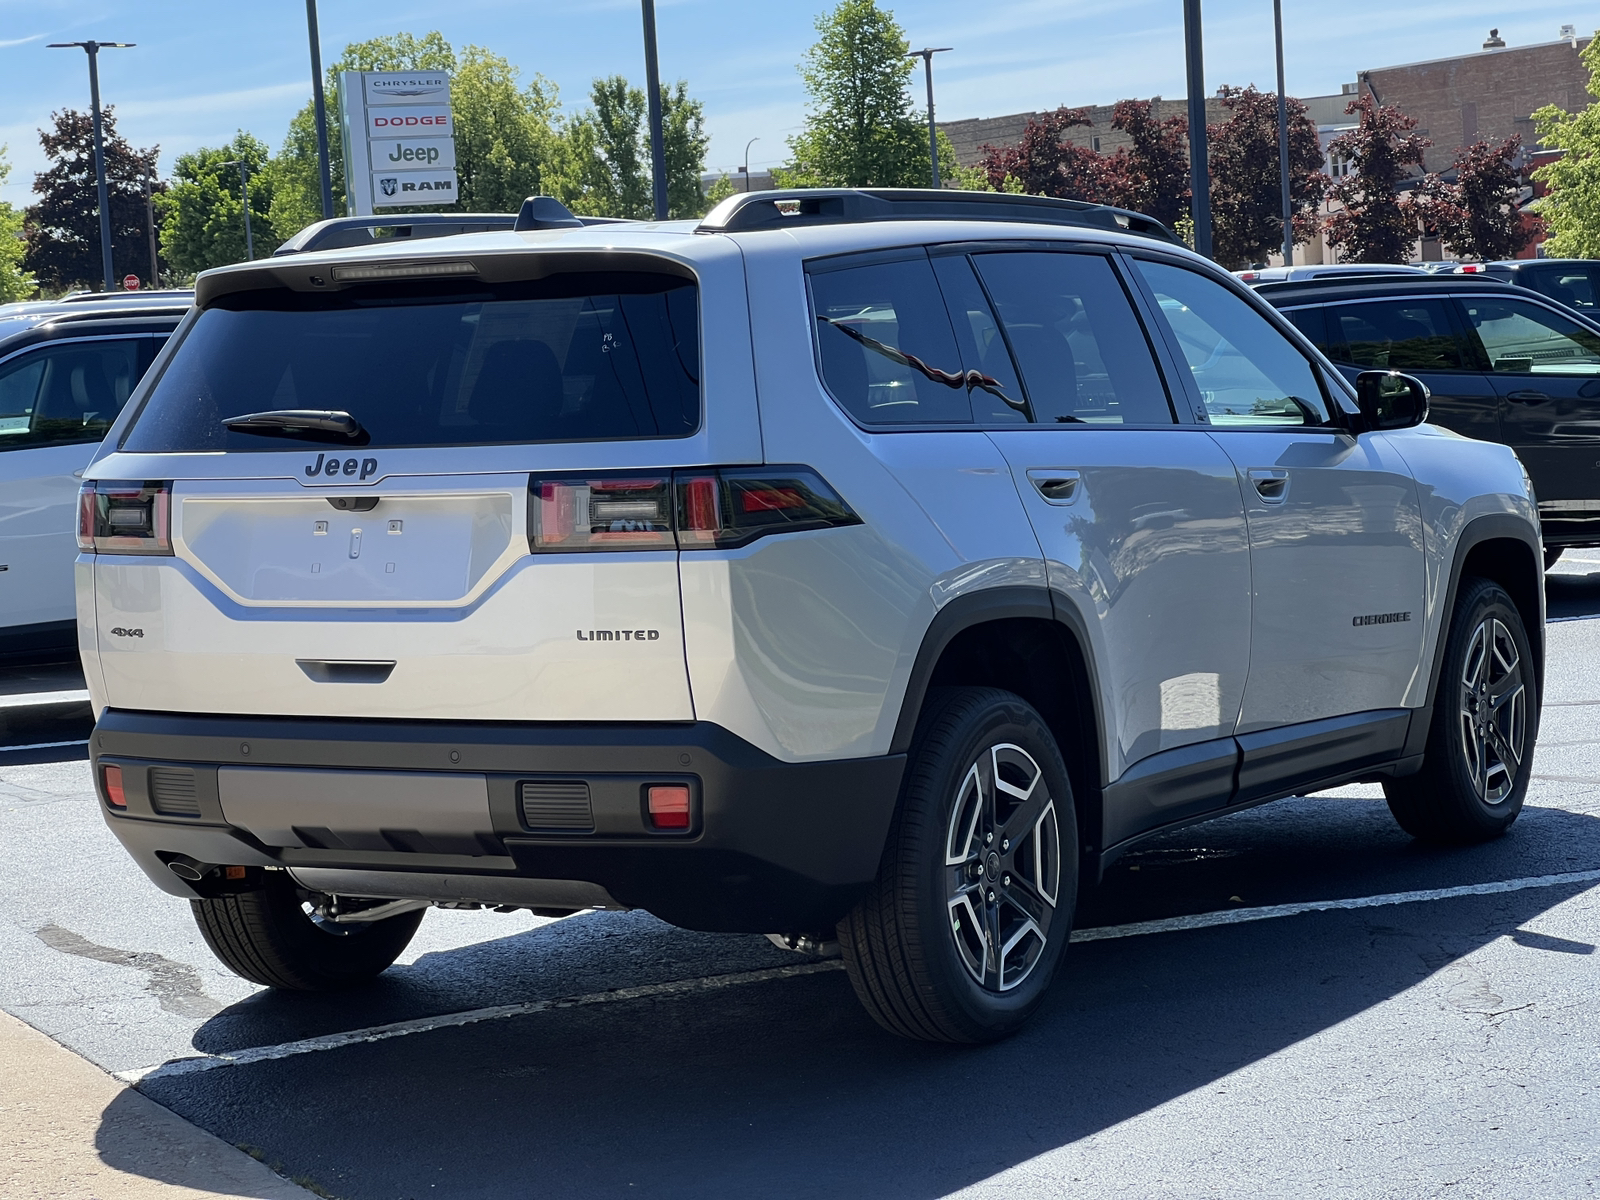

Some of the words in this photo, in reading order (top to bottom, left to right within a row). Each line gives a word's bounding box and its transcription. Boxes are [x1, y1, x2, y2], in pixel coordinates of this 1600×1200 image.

[374, 116, 447, 127] DODGE
[388, 143, 439, 165] Jeep
[402, 181, 452, 192] RAM
[124, 279, 139, 287] STOP
[305, 453, 378, 481] Jeep
[1353, 611, 1411, 627] CHEROKEE
[576, 630, 659, 641] LIMITED
